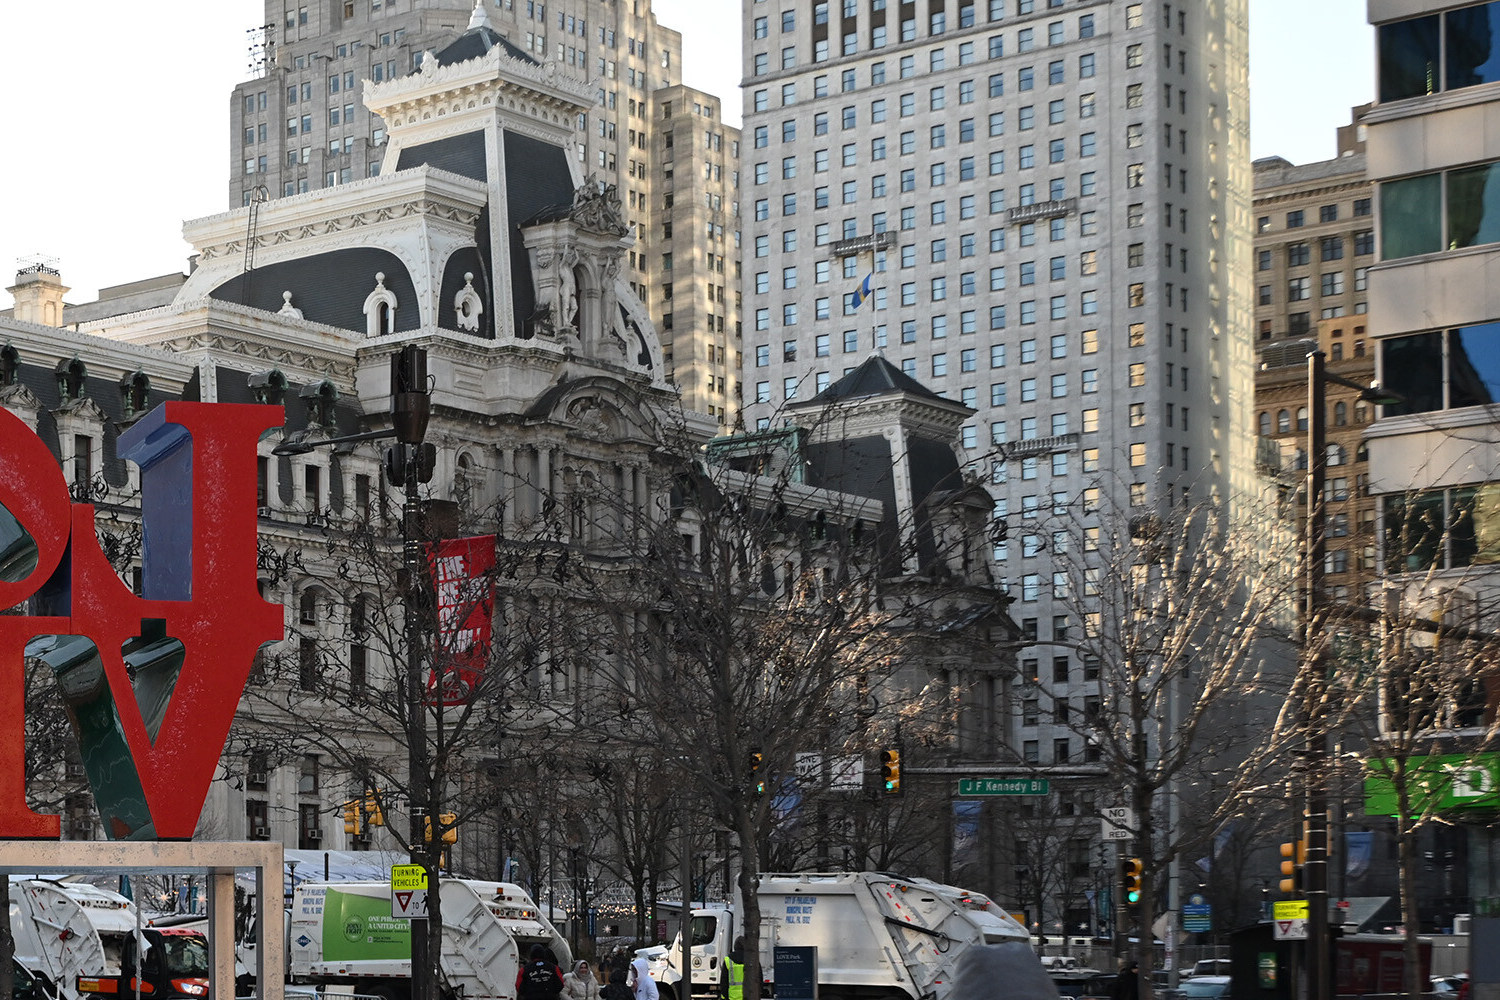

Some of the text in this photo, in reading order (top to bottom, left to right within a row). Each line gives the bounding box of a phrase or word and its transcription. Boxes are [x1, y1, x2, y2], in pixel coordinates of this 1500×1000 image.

[966, 782, 972, 791] J
[976, 782, 982, 791] F
[986, 782, 1026, 793] Kennedy
[1109, 809, 1125, 817] NO
[393, 868, 420, 877] TURNING
[393, 878, 420, 887] VEHICLES
[412, 901, 419, 909] TO
